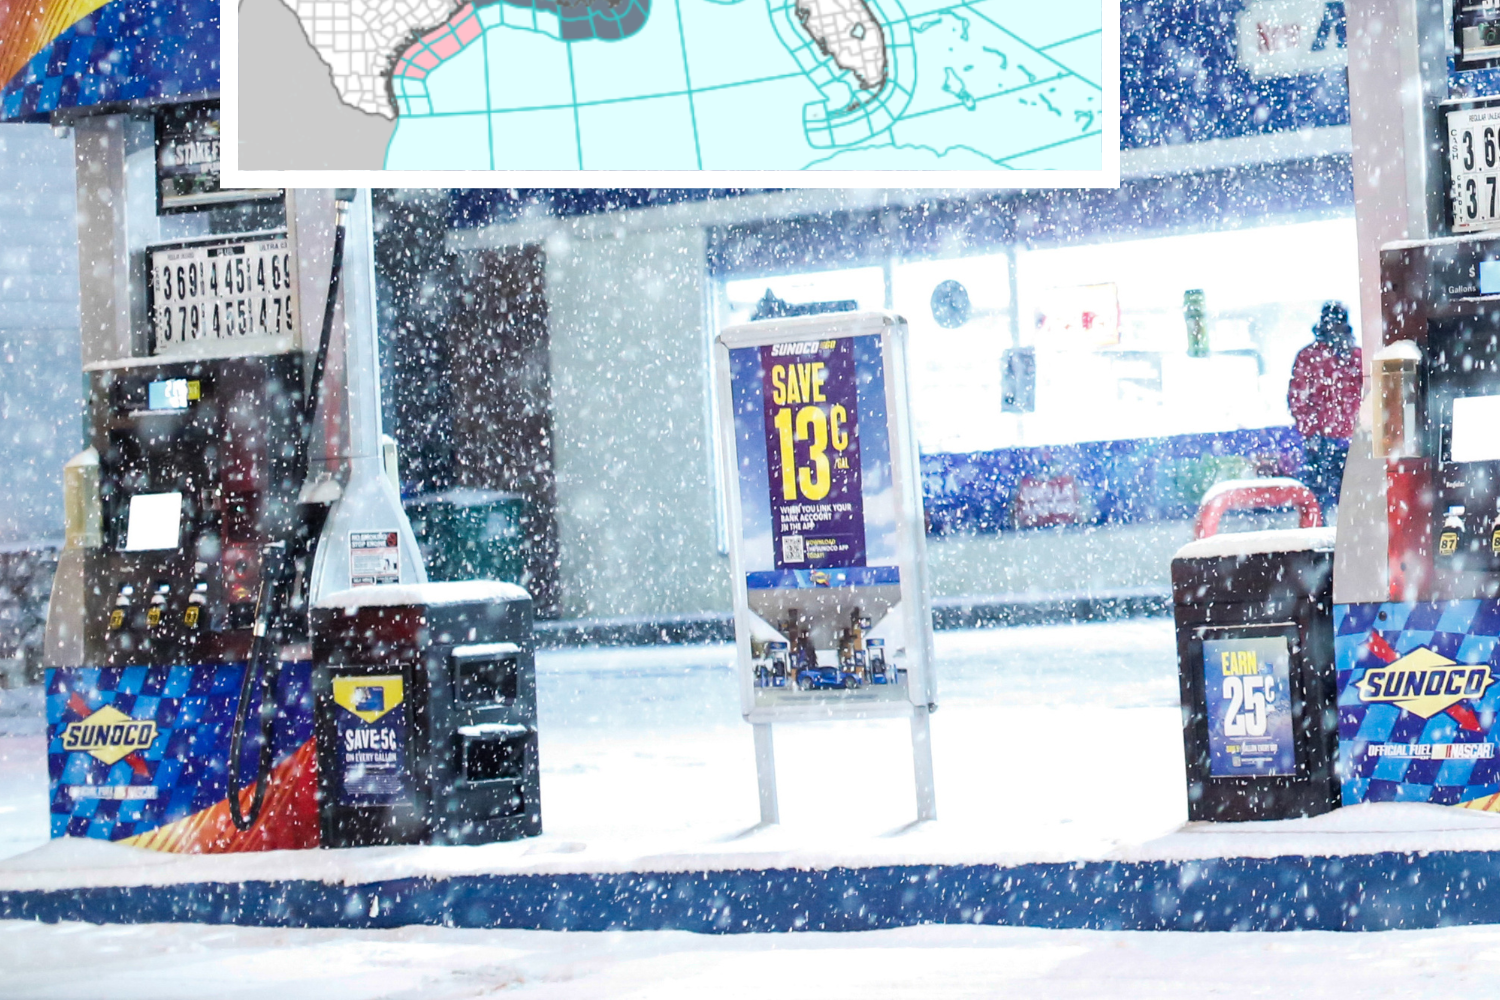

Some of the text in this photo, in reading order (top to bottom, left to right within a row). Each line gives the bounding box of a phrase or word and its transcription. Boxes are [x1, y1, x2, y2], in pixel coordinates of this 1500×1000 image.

[1469, 113, 1486, 122] REGULAR
[175, 140, 210, 165] STAKE
[1448, 285, 1477, 294] Gallons
[771, 341, 820, 357] SUNOCO
[771, 362, 827, 405] SAVE
[1446, 481, 1466, 489] Regular
[780, 503, 852, 514] WHEN YOU LINK YOUR
[781, 513, 832, 522] BANK ACCOUNT
[790, 522, 801, 531] THE
[1440, 538, 1456, 549] 87
[1221, 650, 1258, 676] EARN
[1364, 669, 1487, 698] SUNOCO
[66, 724, 153, 747] SUNOCO
[345, 728, 380, 752] SAVE
[355, 752, 374, 762] EVERY
[375, 751, 397, 762] GALLON
[1368, 744, 1407, 757] OFFICIAL
[1409, 743, 1432, 756] FUEL
[1450, 742, 1495, 759] NASCAR
